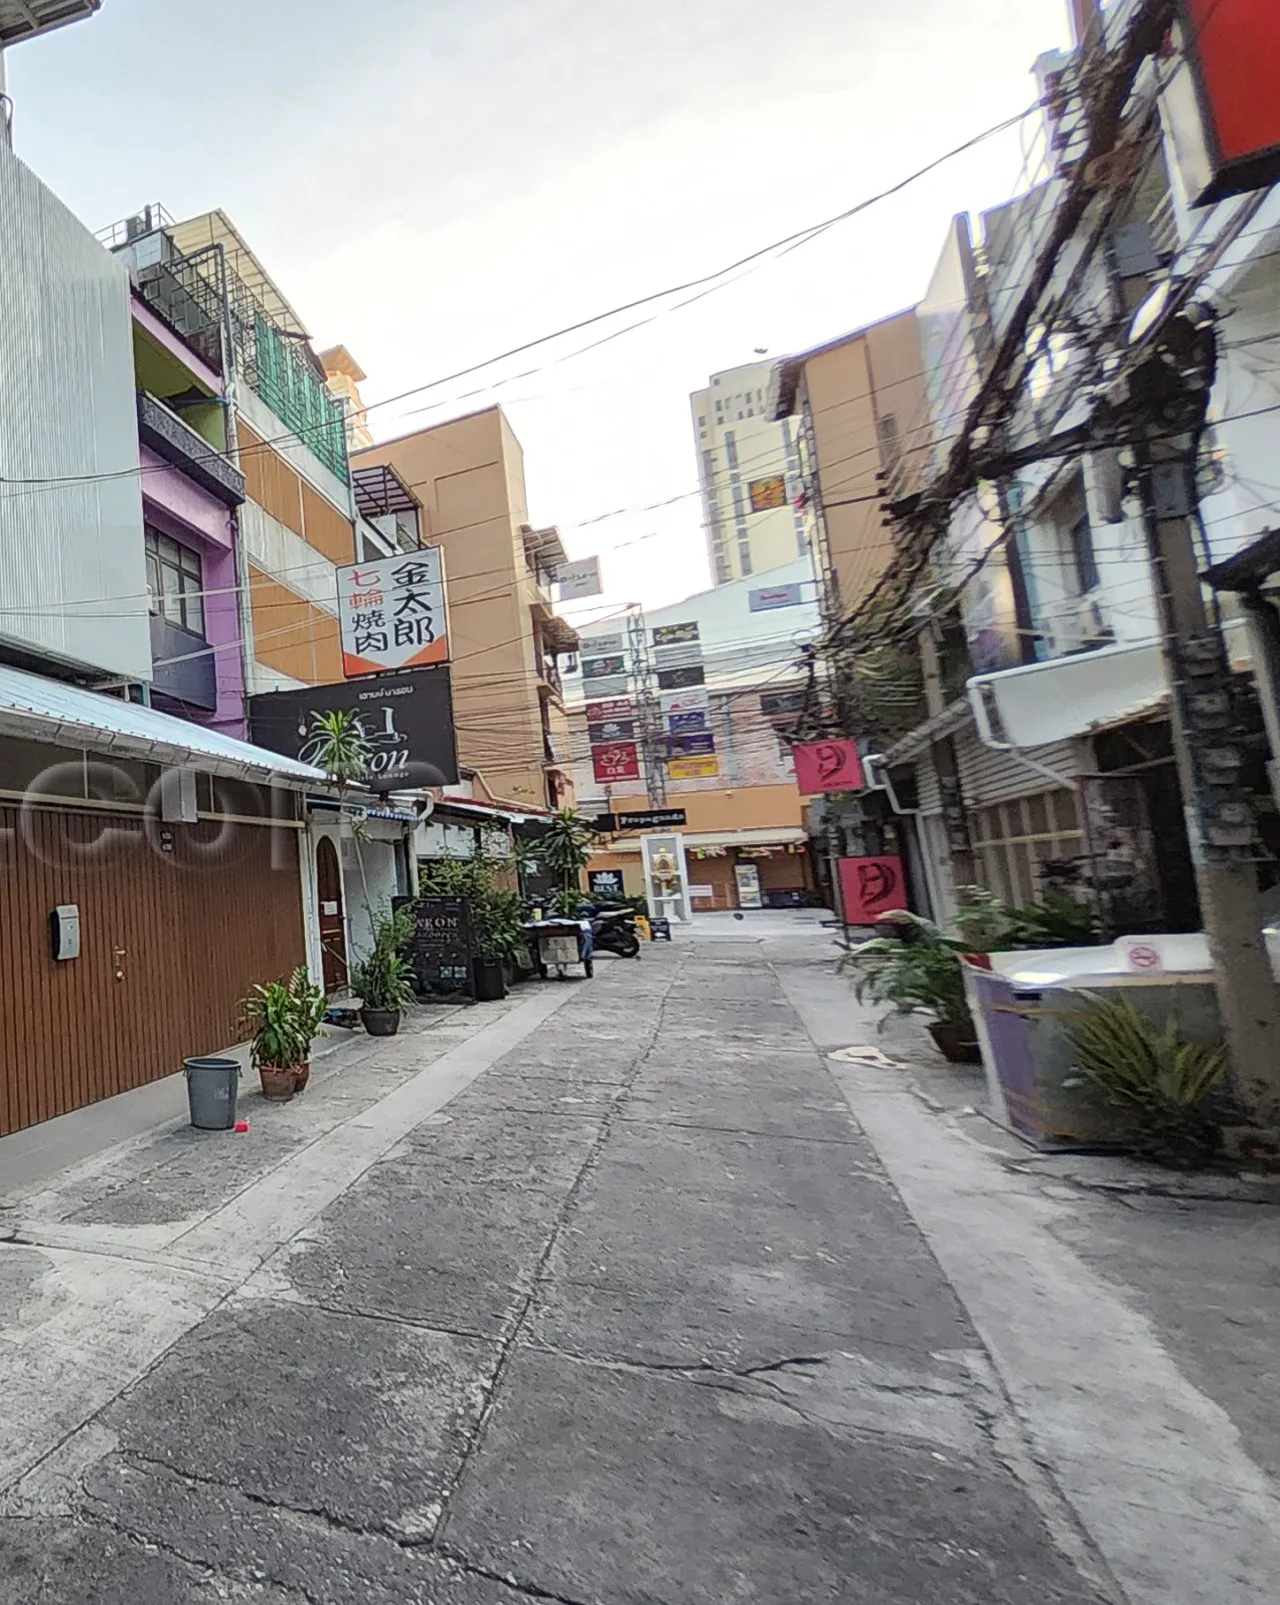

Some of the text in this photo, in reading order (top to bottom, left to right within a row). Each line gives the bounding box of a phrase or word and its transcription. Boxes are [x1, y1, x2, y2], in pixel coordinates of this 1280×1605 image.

[390, 561, 435, 647] 金太郎
[620, 813, 685, 825] Propaganda
[593, 884, 620, 893] BEST
